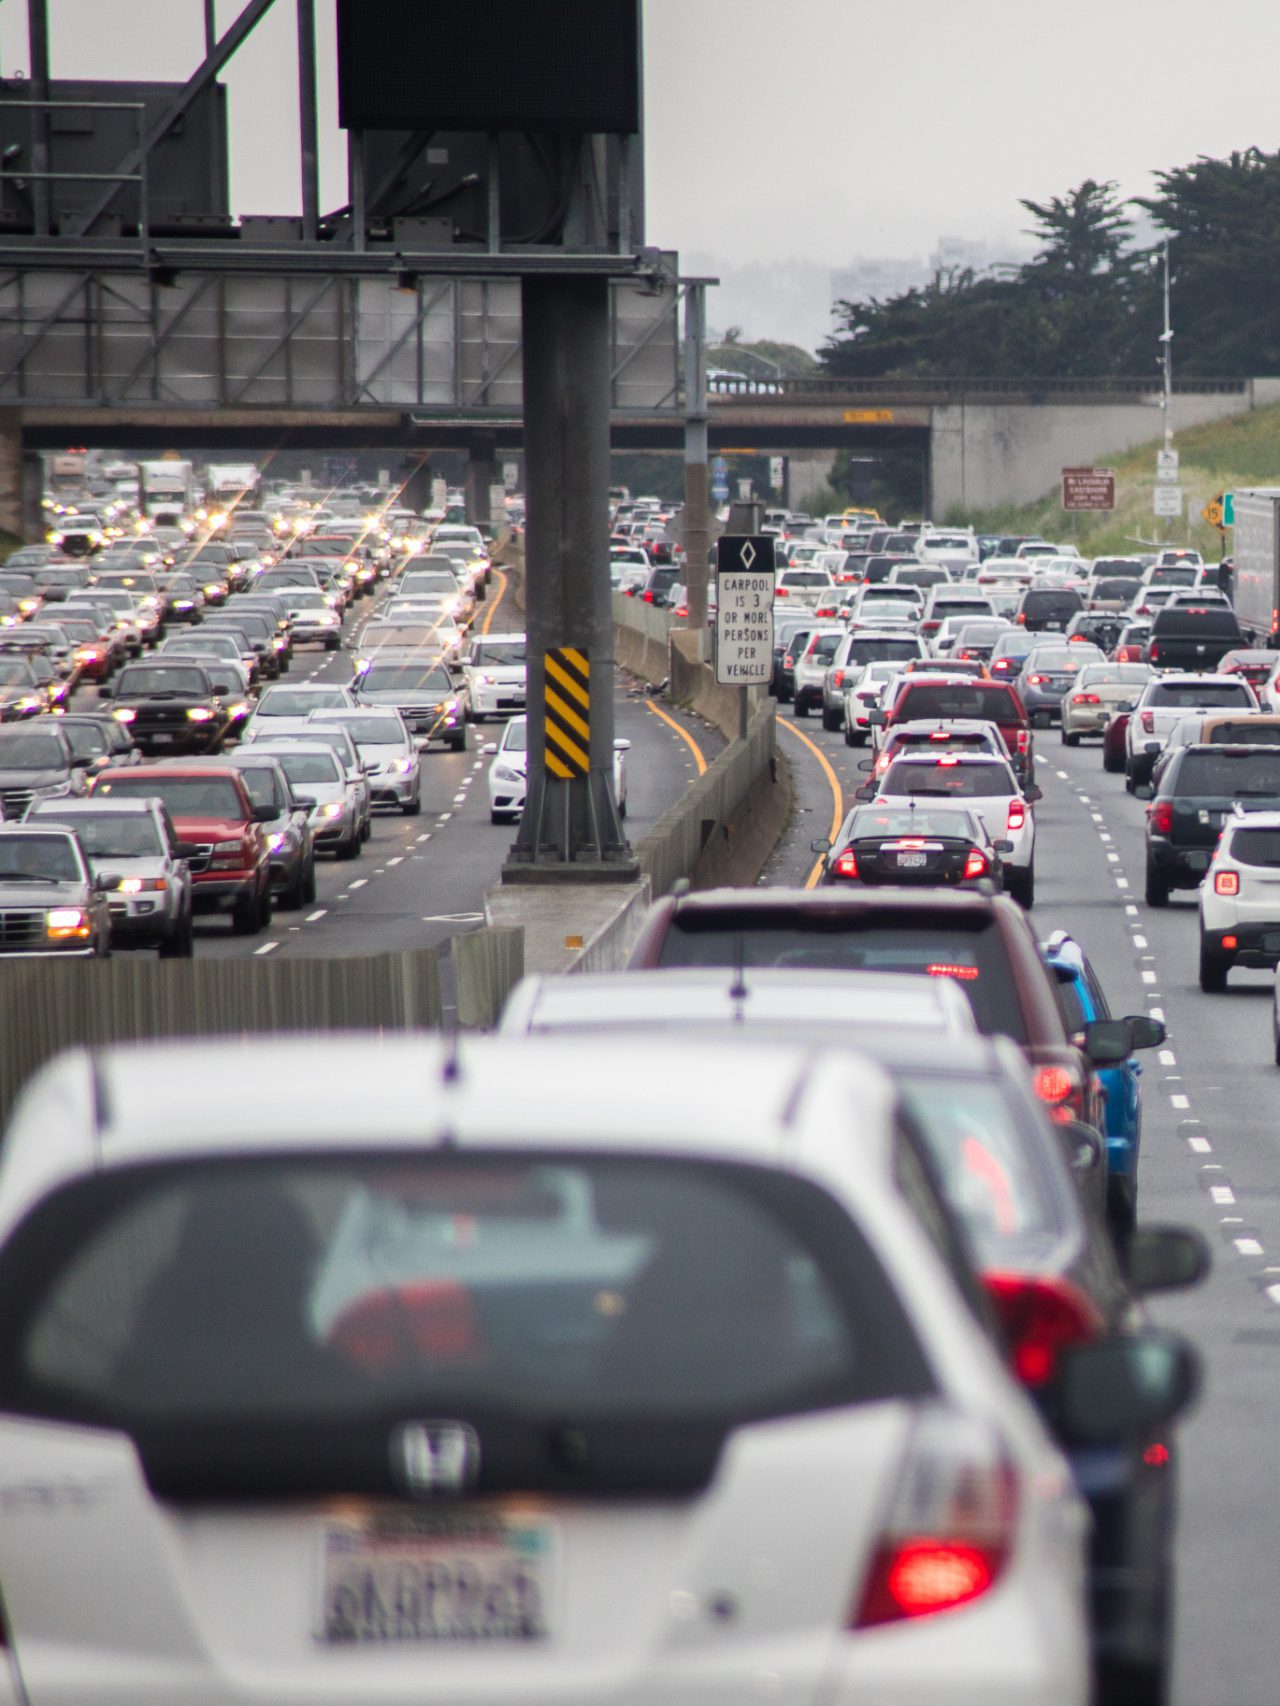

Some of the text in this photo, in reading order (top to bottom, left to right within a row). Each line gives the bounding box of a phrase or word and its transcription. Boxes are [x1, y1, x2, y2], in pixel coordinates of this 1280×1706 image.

[724, 579, 770, 592] CARPOOL
[736, 594, 760, 608] IS 3
[724, 611, 769, 624] OR MORE
[724, 628, 769, 642] PERSONS
[737, 647, 757, 659] PER
[726, 664, 766, 677] VEHICLE
